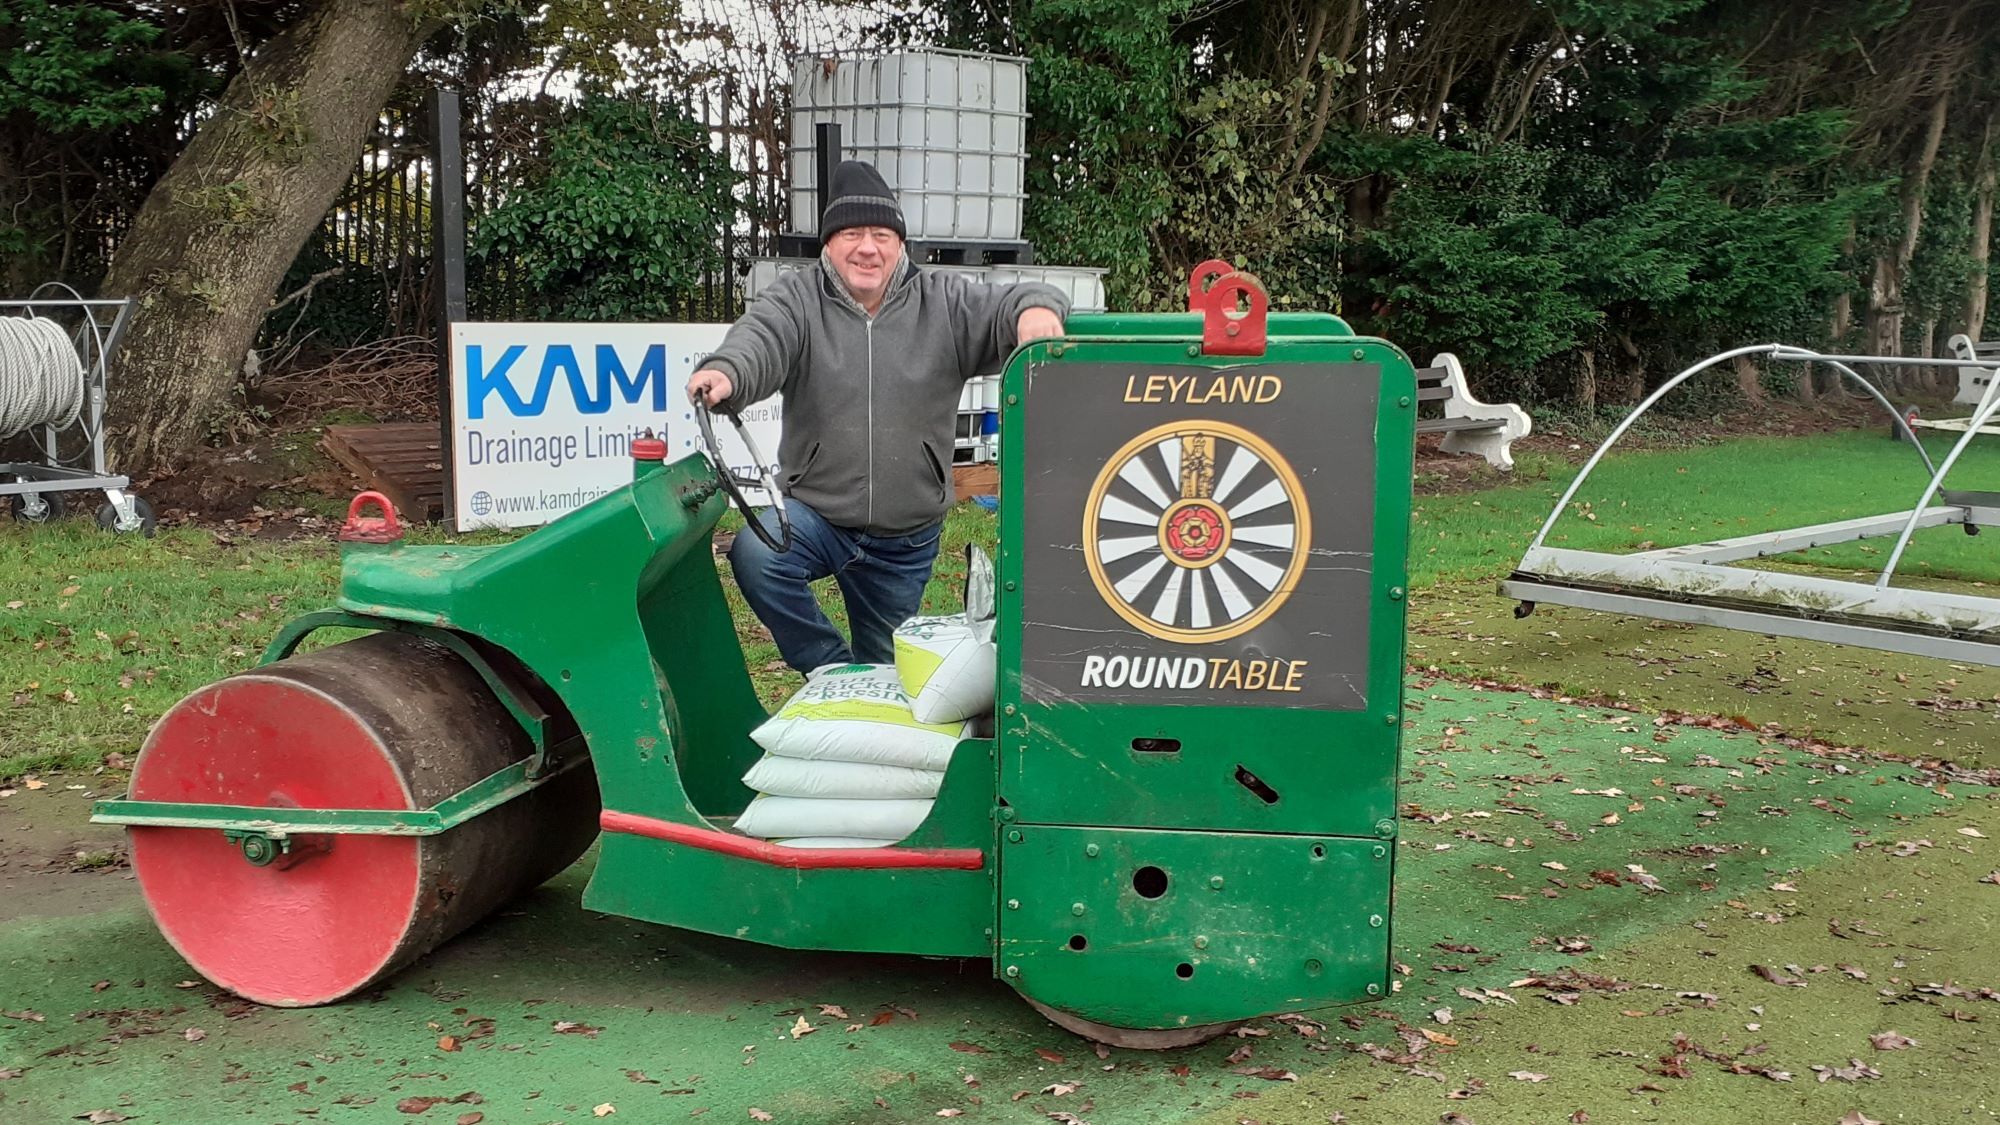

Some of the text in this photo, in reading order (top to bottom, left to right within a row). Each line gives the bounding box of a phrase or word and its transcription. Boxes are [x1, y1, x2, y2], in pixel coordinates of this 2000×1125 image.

[465, 344, 667, 420] KAM
[1123, 374, 1283, 404] LEYLAND
[467, 422, 669, 468] Drainage Limitd
